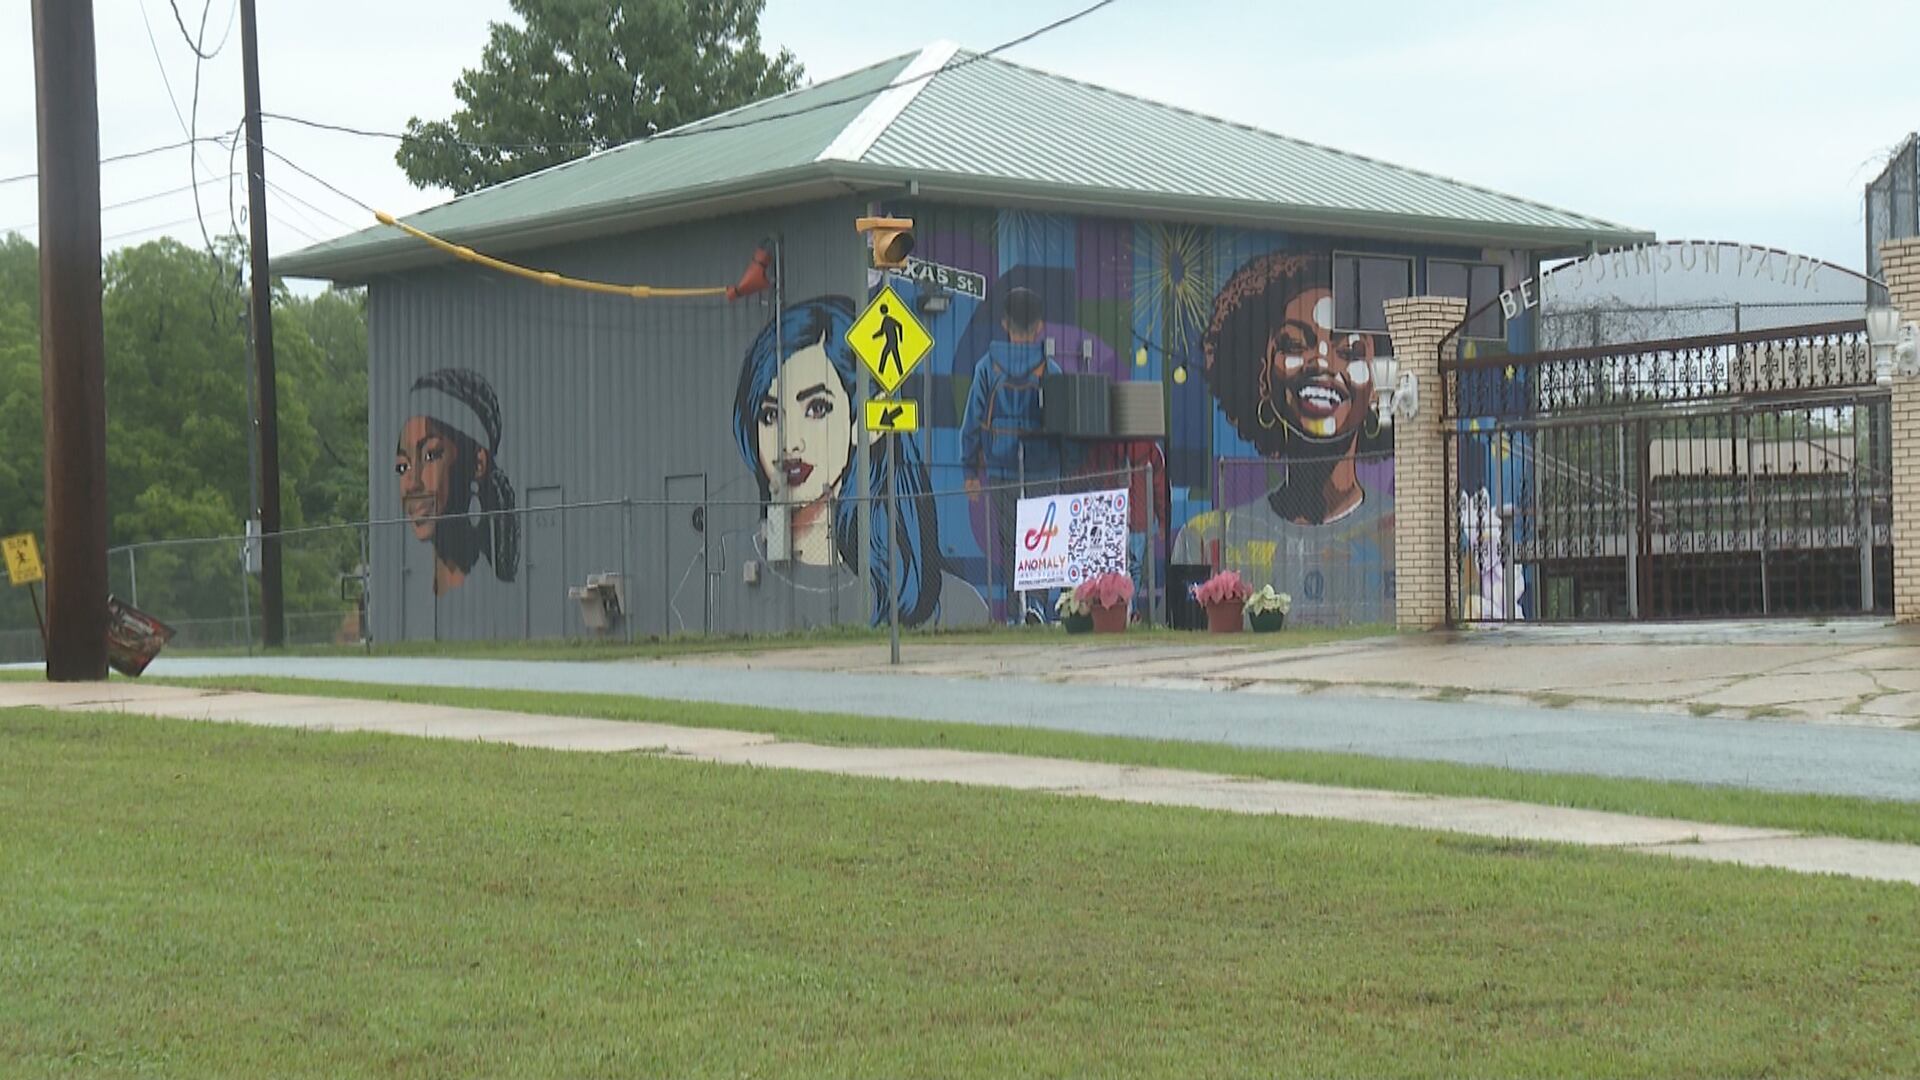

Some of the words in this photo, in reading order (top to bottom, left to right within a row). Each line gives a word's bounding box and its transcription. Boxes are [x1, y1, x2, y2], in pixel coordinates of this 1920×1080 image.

[889, 260, 949, 285] XAS
[1499, 268, 1559, 320] BEN
[1570, 239, 1720, 290] JOHNSON
[1738, 243, 1824, 293] PARK
[1018, 555, 1066, 571] ANOMALY
